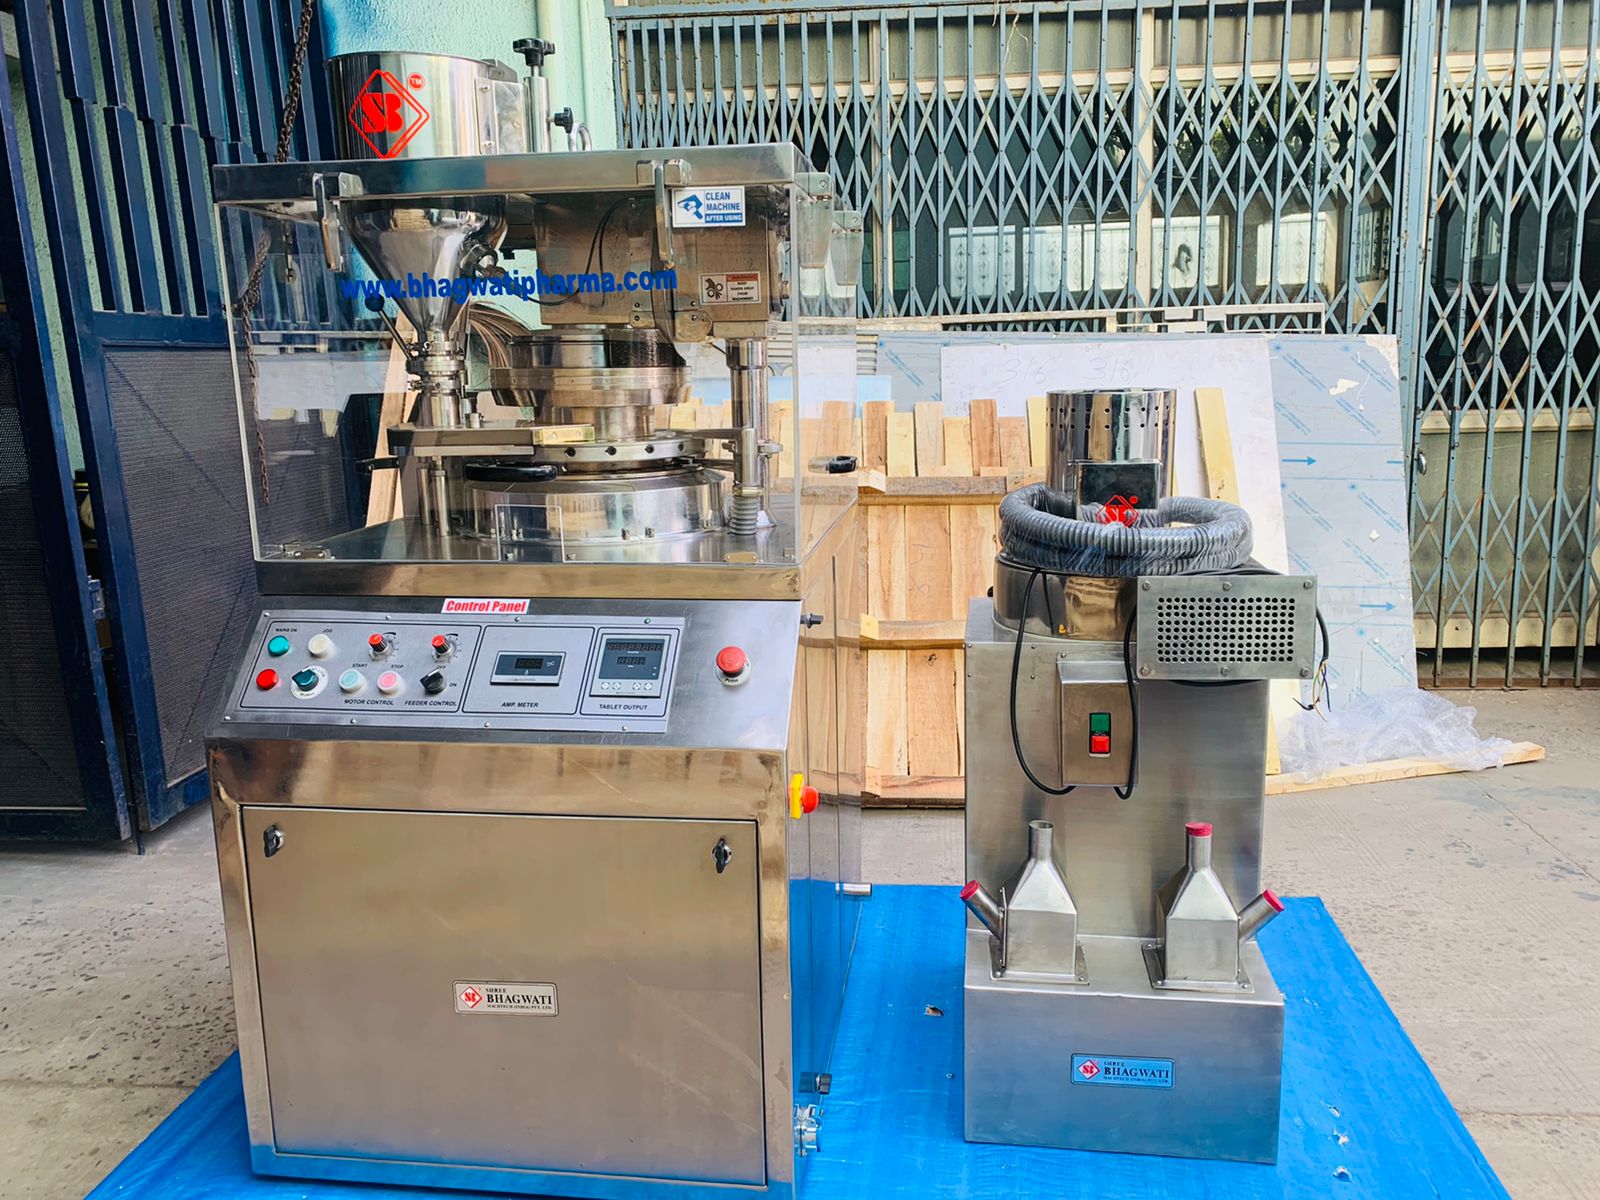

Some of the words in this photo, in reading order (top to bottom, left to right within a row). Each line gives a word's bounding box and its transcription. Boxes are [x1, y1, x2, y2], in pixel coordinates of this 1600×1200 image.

[361, 92, 404, 134] SB
[705, 192, 731, 200] CLEAN
[706, 202, 741, 211] MACHINE
[340, 269, 678, 303] www.bhagwatipharma.com
[445, 600, 489, 612] Control
[491, 600, 528, 613] Panel
[486, 994, 552, 1005] BHAGWATI
[1104, 1067, 1169, 1078] BHAGWATI
